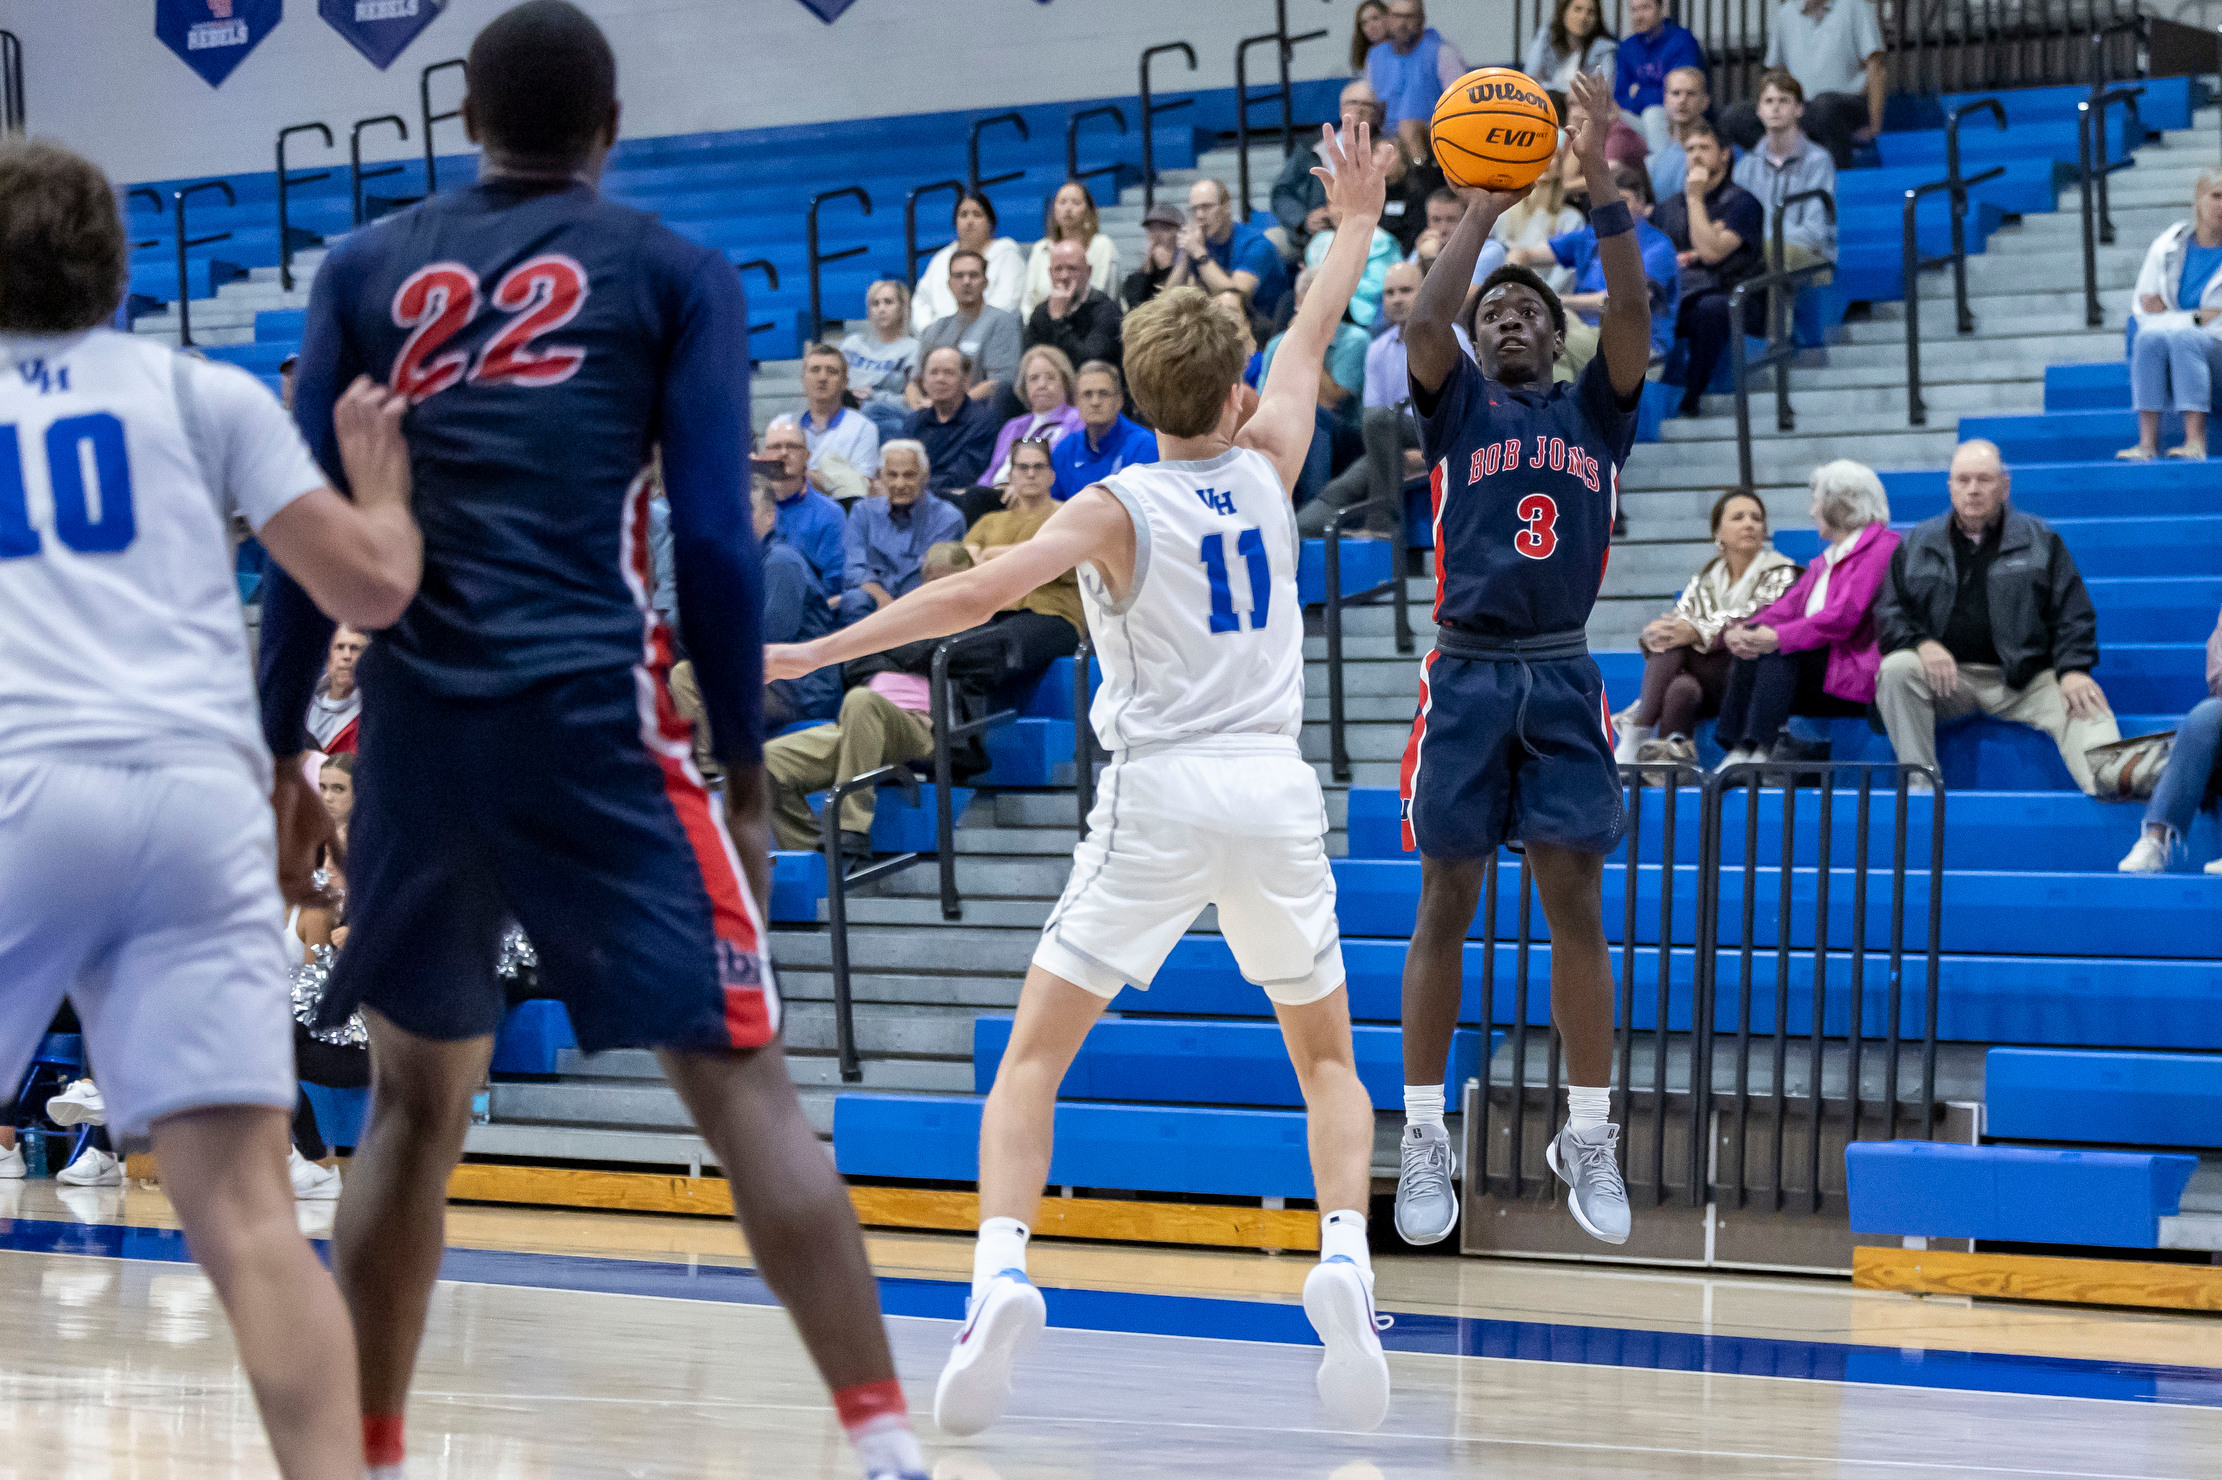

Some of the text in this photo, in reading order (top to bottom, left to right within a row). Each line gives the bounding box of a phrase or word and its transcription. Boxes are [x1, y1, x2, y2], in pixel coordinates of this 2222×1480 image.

[1466, 82, 1549, 114] Wilson
[1485, 128, 1536, 147] EVO
[388, 254, 590, 405] 22
[1467, 438, 1522, 486] BOB
[1195, 487, 1238, 516] VH
[1514, 492, 1560, 560] 3
[1199, 526, 1273, 635] 11
